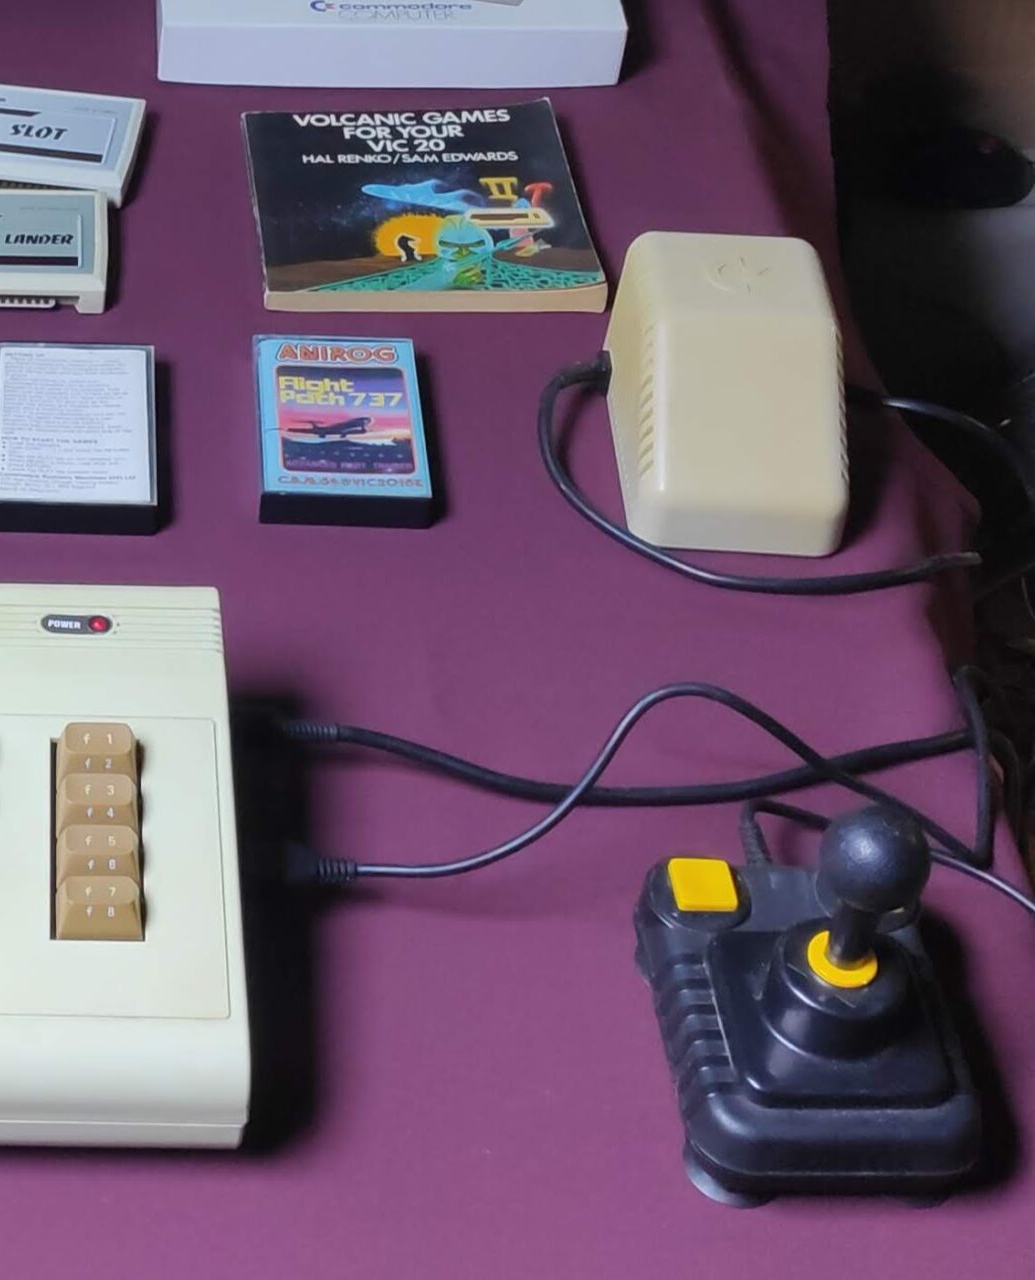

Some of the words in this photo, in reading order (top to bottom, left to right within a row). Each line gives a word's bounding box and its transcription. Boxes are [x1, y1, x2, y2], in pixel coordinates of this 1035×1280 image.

[339, 1, 473, 11] commodore
[292, 112, 417, 127] VOLCANIC
[421, 109, 511, 125] GAMES
[10, 123, 68, 141] SLOT
[343, 126, 393, 139] FOR
[395, 124, 465, 139] YOUR
[366, 139, 409, 153] VIC
[413, 138, 446, 152] 20
[302, 154, 336, 164] HAL
[441, 151, 519, 163] EDWARDS
[4, 233, 74, 245] LANDER
[276, 342, 399, 363] ANIROG
[278, 375, 355, 395] Flight
[348, 392, 404, 407] 737
[47, 619, 81, 629] POWER
